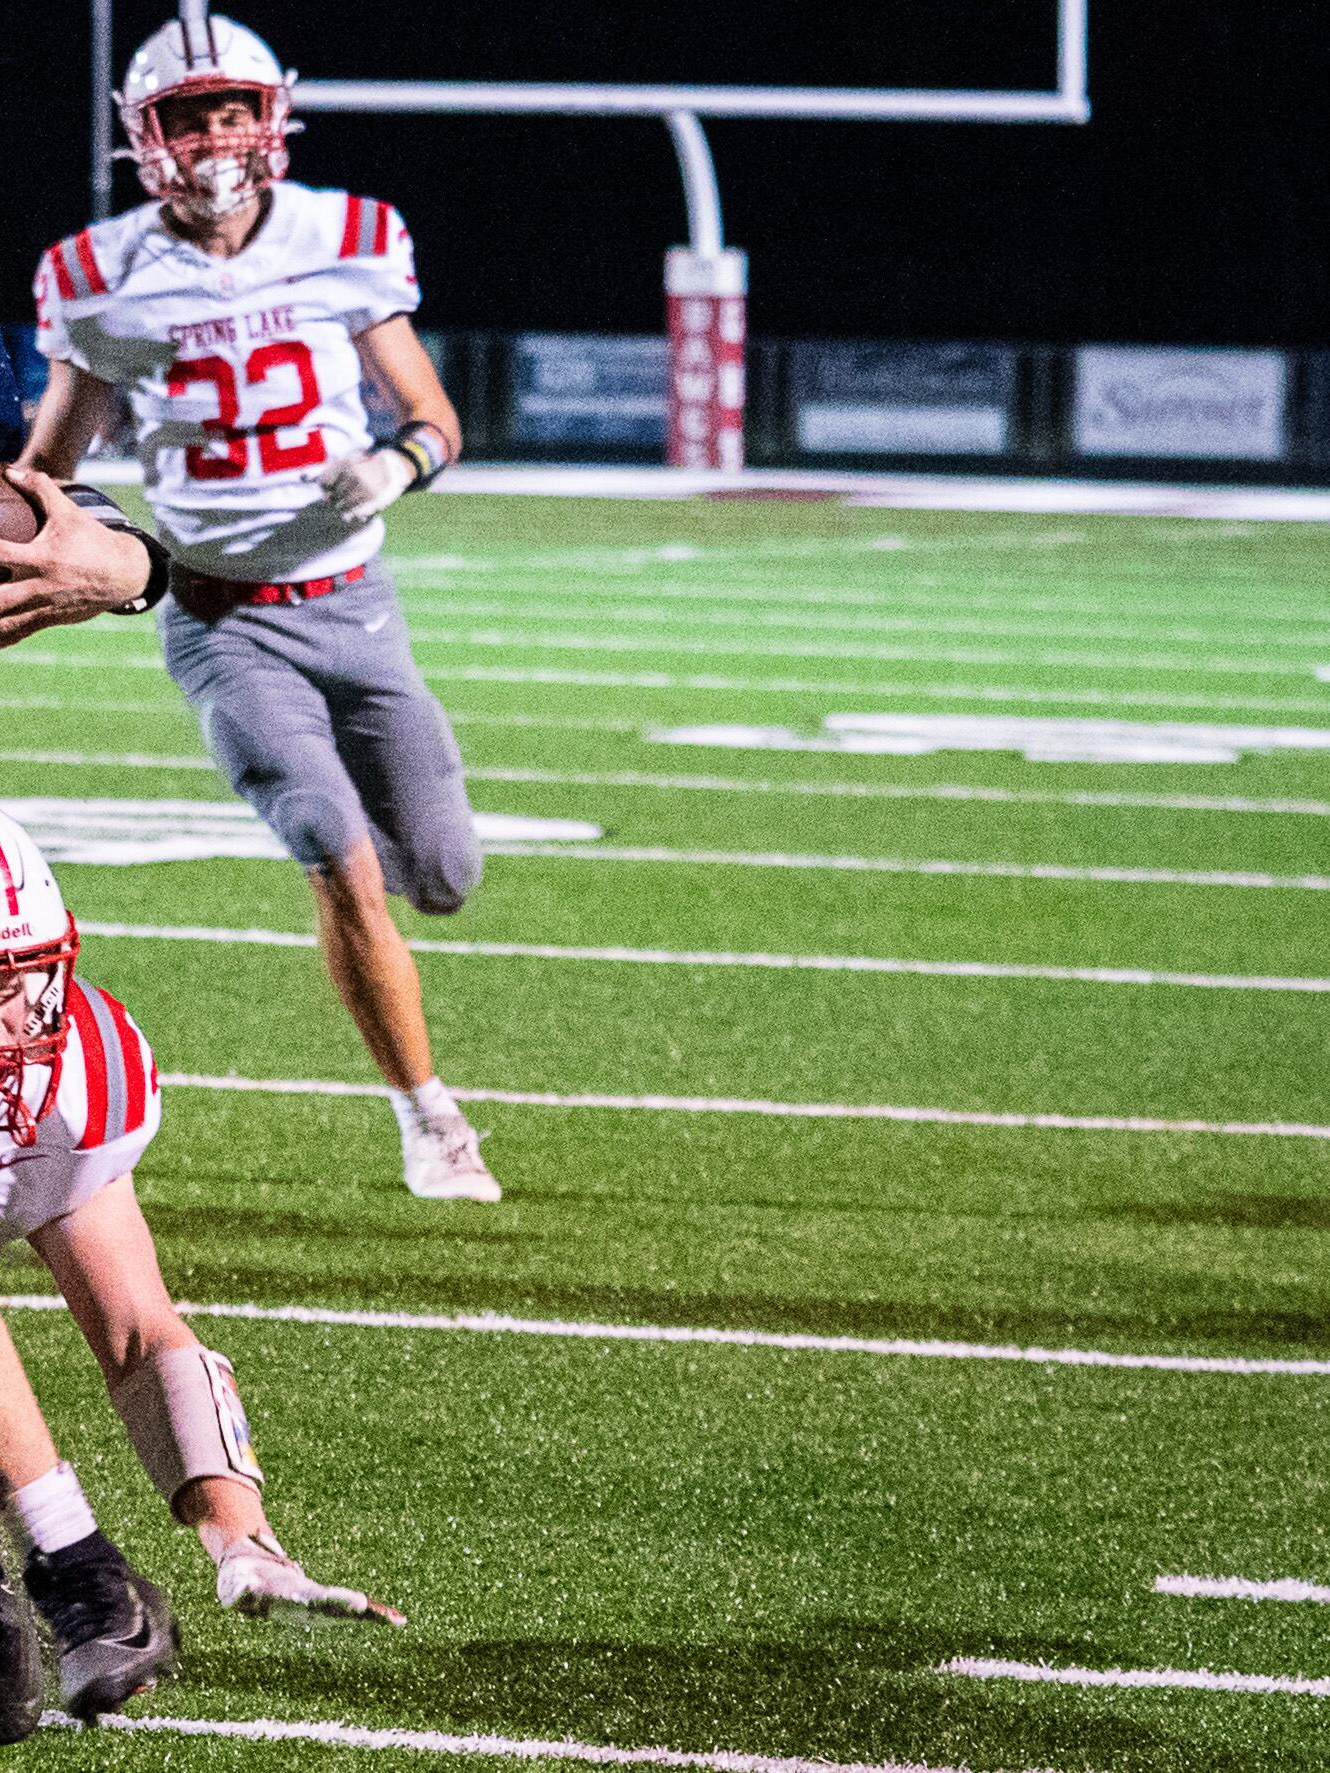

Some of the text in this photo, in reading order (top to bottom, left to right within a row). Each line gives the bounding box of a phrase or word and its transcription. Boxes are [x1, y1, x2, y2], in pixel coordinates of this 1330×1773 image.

[168, 304, 295, 352] SPRING LAKE
[166, 340, 327, 480] 32
